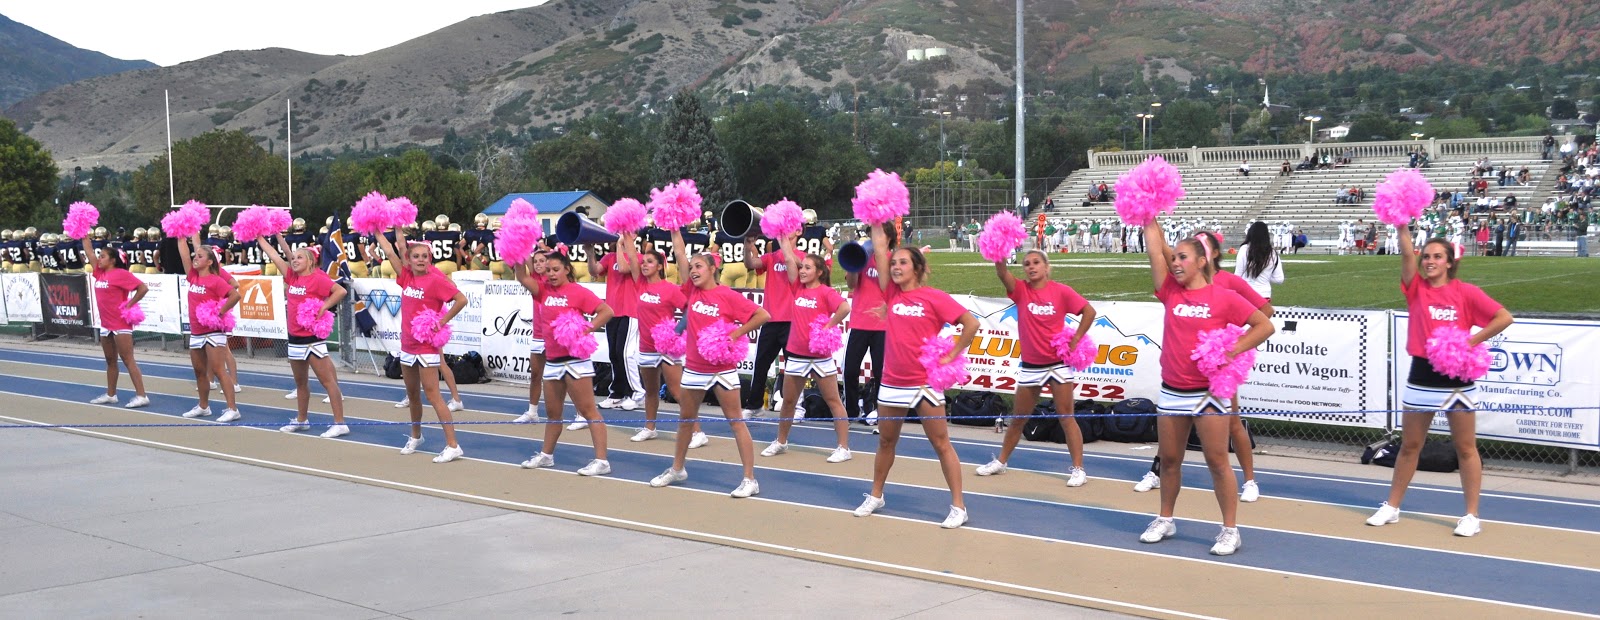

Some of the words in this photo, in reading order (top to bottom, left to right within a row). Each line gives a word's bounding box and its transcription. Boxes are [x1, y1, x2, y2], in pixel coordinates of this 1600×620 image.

[431, 240, 453, 259] 65
[722, 242, 744, 262] 88
[485, 284, 502, 295] MENTION
[56, 306, 78, 316] KFAN
[243, 325, 260, 334] Banking
[1479, 385, 1544, 398] Manufacturing
[1547, 389, 1562, 397] Co.
[1516, 419, 1548, 428] CABINETRY
[1564, 421, 1584, 430] EVERY
